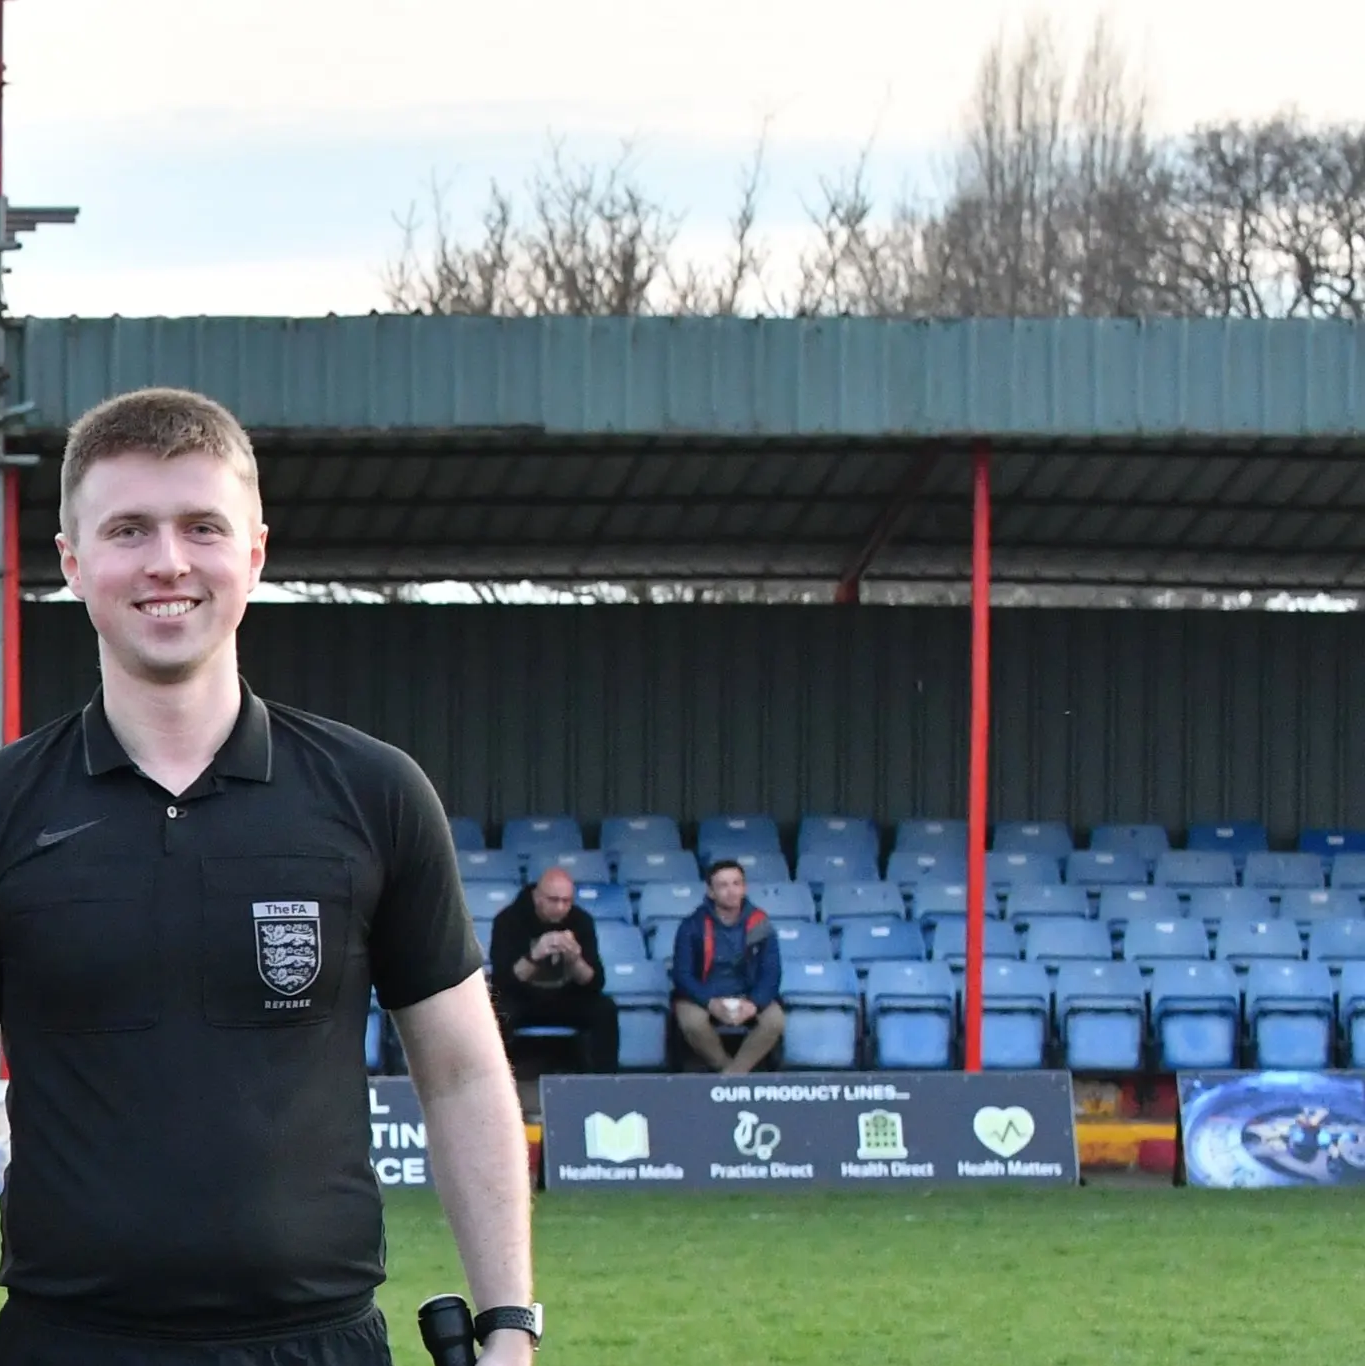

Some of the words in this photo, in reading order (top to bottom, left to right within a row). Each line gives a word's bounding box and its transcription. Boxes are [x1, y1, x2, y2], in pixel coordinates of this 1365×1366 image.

[264, 999, 311, 1009] REFEREE
[710, 1086, 751, 1102] OUR
[754, 1085, 841, 1101] PRODUCT
[559, 1163, 637, 1180] Healthcare
[639, 1163, 684, 1180] Media
[710, 1162, 768, 1179] Practice
[770, 1162, 814, 1179] Direct
[841, 1161, 889, 1178] Health
[891, 1161, 934, 1178] Direct
[957, 1160, 1005, 1177] Health
[1007, 1160, 1062, 1177] Matters
